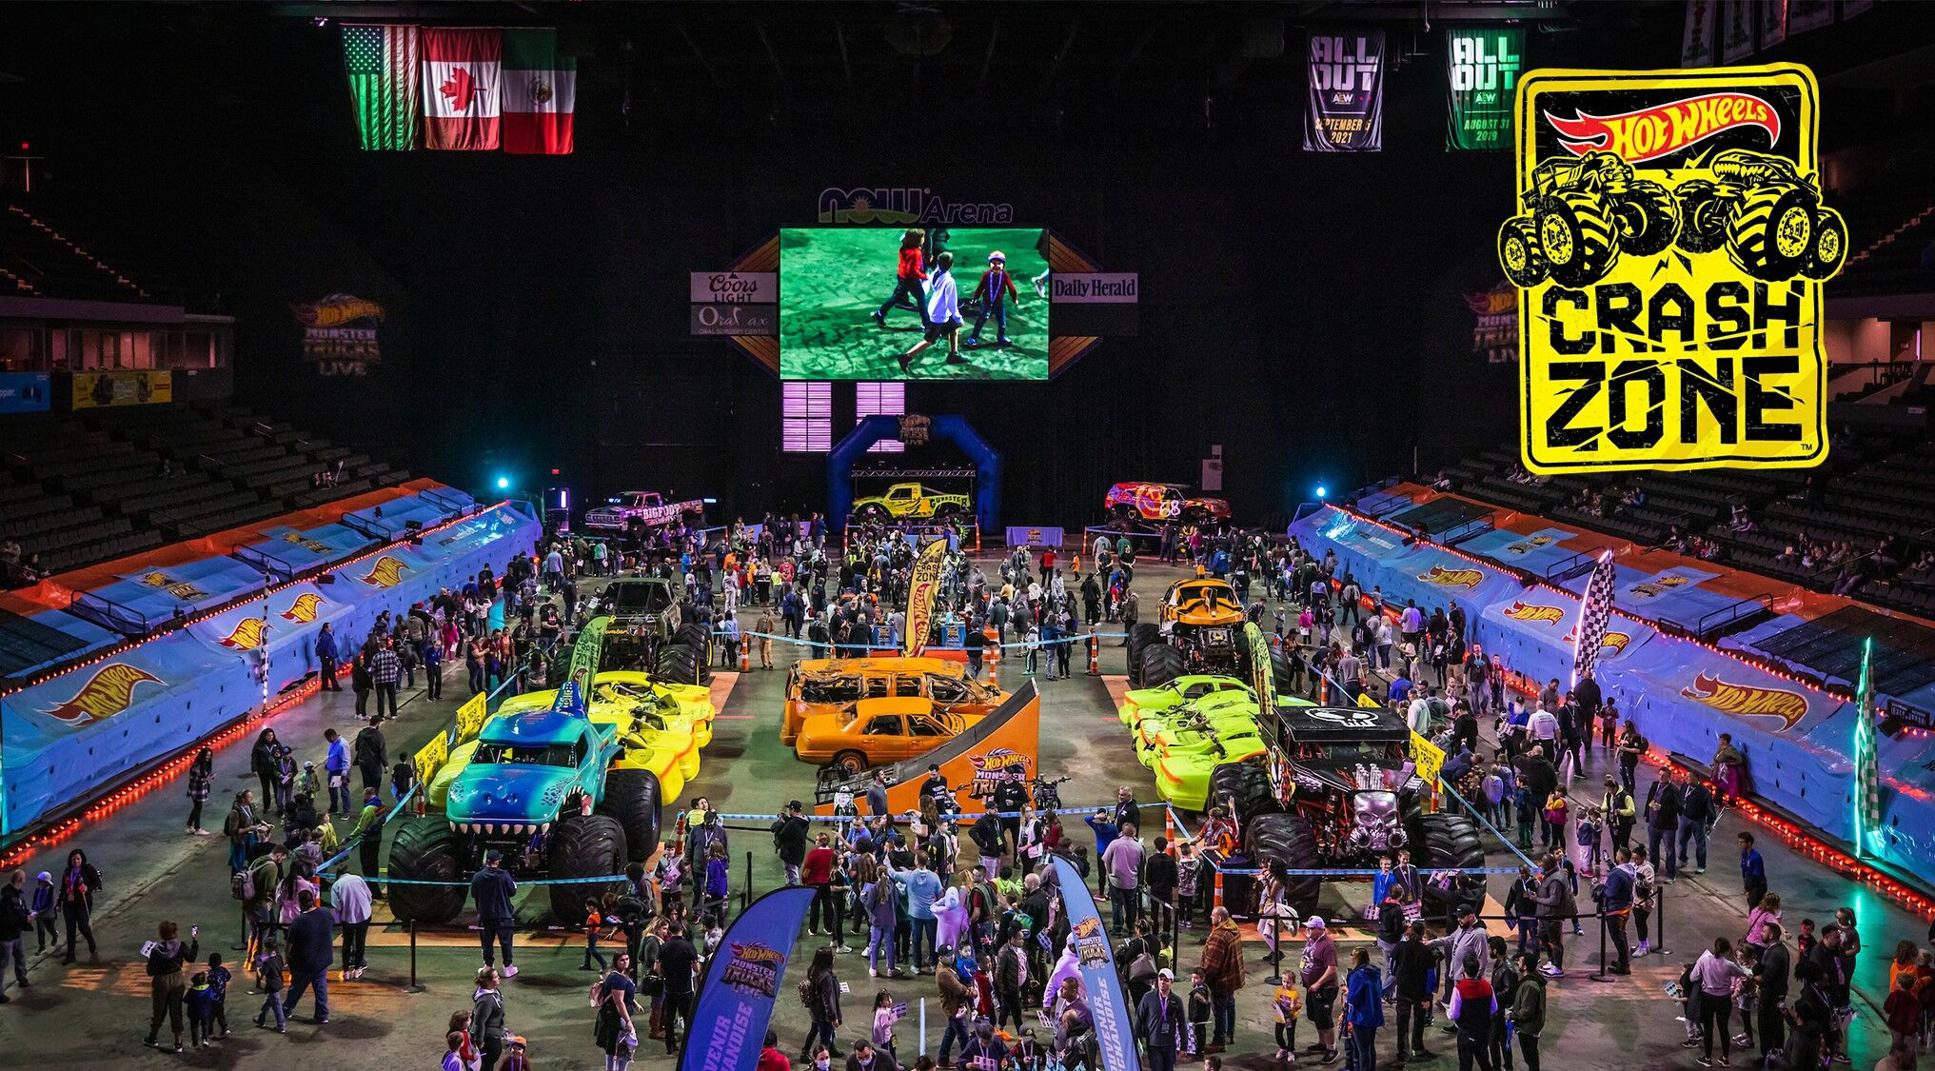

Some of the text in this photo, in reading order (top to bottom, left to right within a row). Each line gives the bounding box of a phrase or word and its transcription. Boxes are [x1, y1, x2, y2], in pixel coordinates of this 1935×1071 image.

[1311, 36, 1378, 63] ALL
[1453, 36, 1520, 64] ALL
[1311, 64, 1377, 91] OUT
[1452, 63, 1520, 91] OUT
[1464, 119, 1510, 130] AUGUST 31
[1331, 131, 1352, 143] 2021
[1476, 131, 1498, 141] 2019
[919, 195, 1014, 224] Arena
[708, 274, 758, 292] Coors
[1055, 279, 1136, 297] Daily Herald
[714, 293, 753, 304] LIGHT
[976, 770, 1025, 781] MONSER
